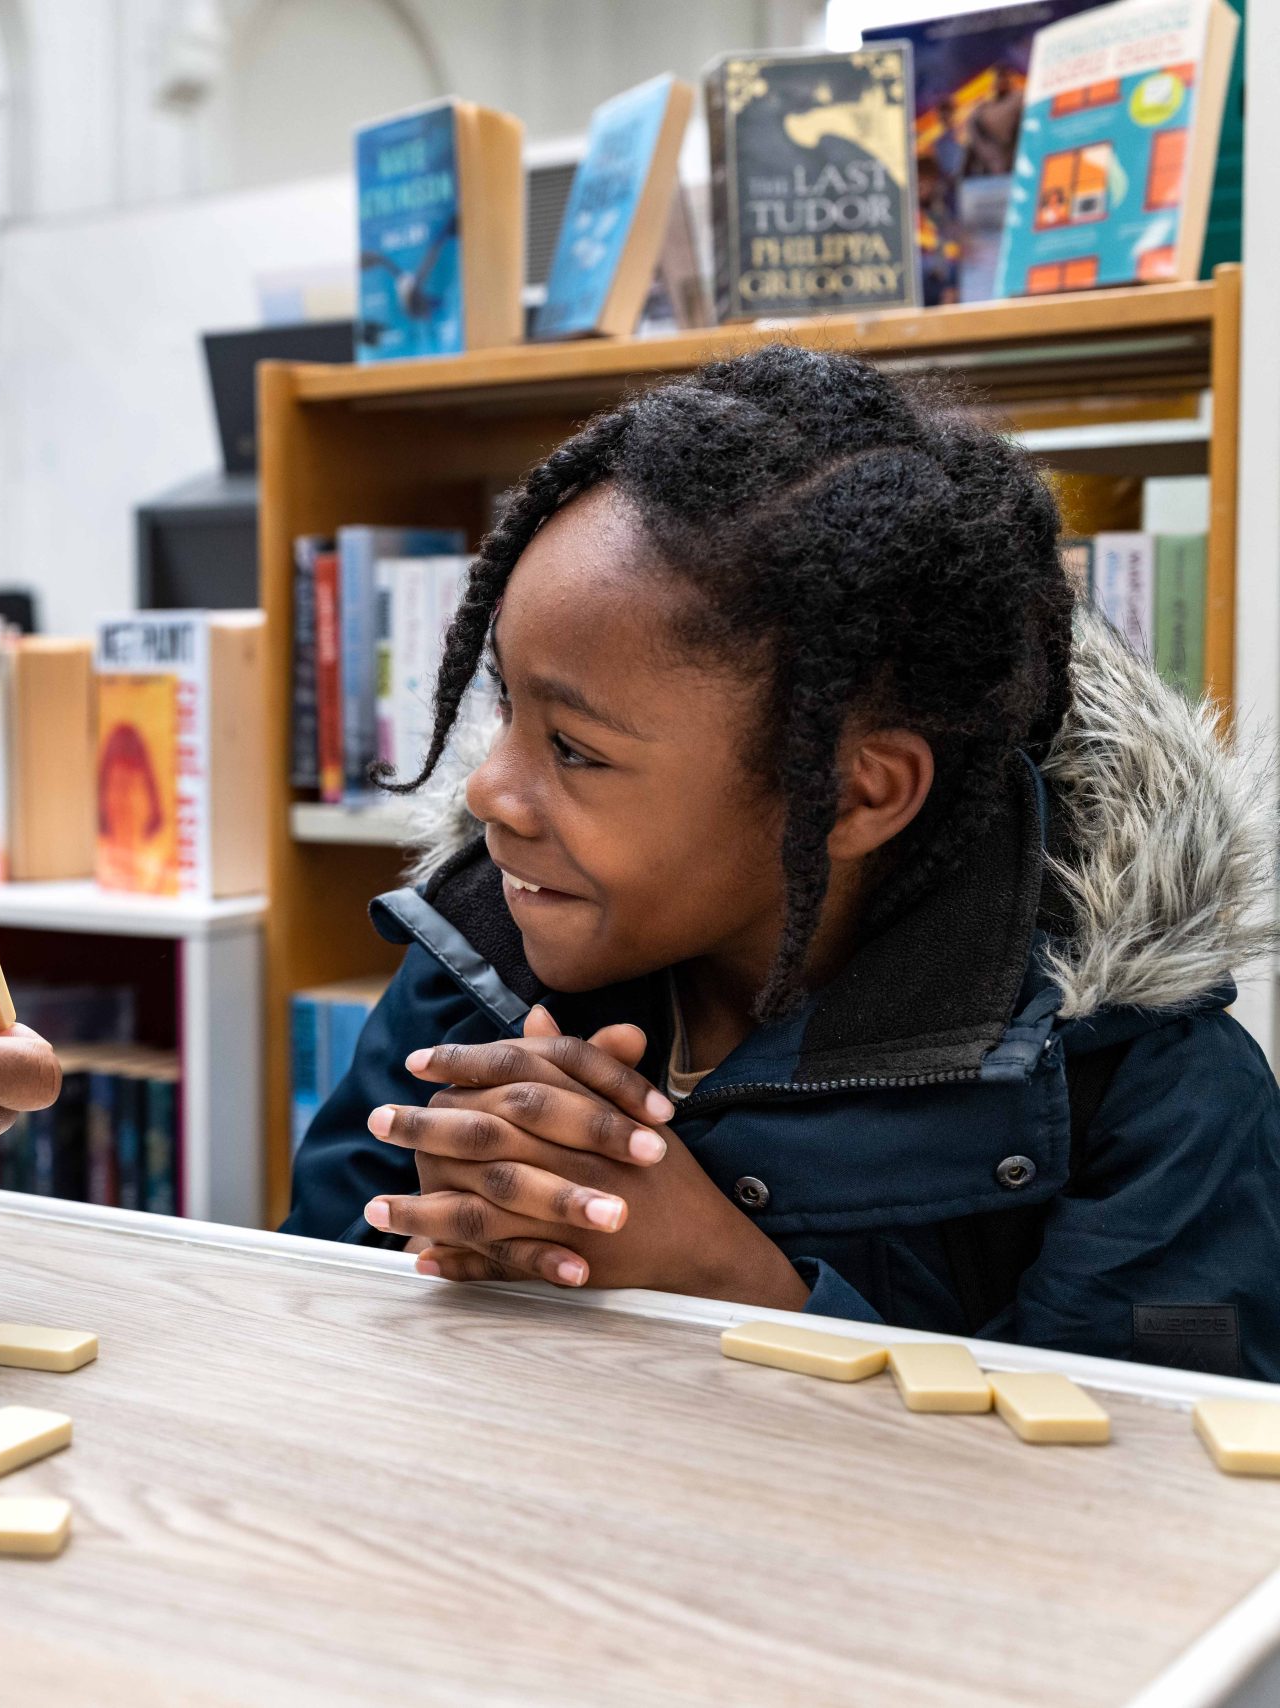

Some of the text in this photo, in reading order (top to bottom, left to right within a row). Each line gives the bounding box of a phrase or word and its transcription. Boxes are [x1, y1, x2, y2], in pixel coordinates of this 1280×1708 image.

[793, 160, 890, 197] LAST
[747, 193, 894, 234] TUDOR
[750, 231, 892, 268] PHILIPPA
[738, 262, 904, 301] GREGORY
